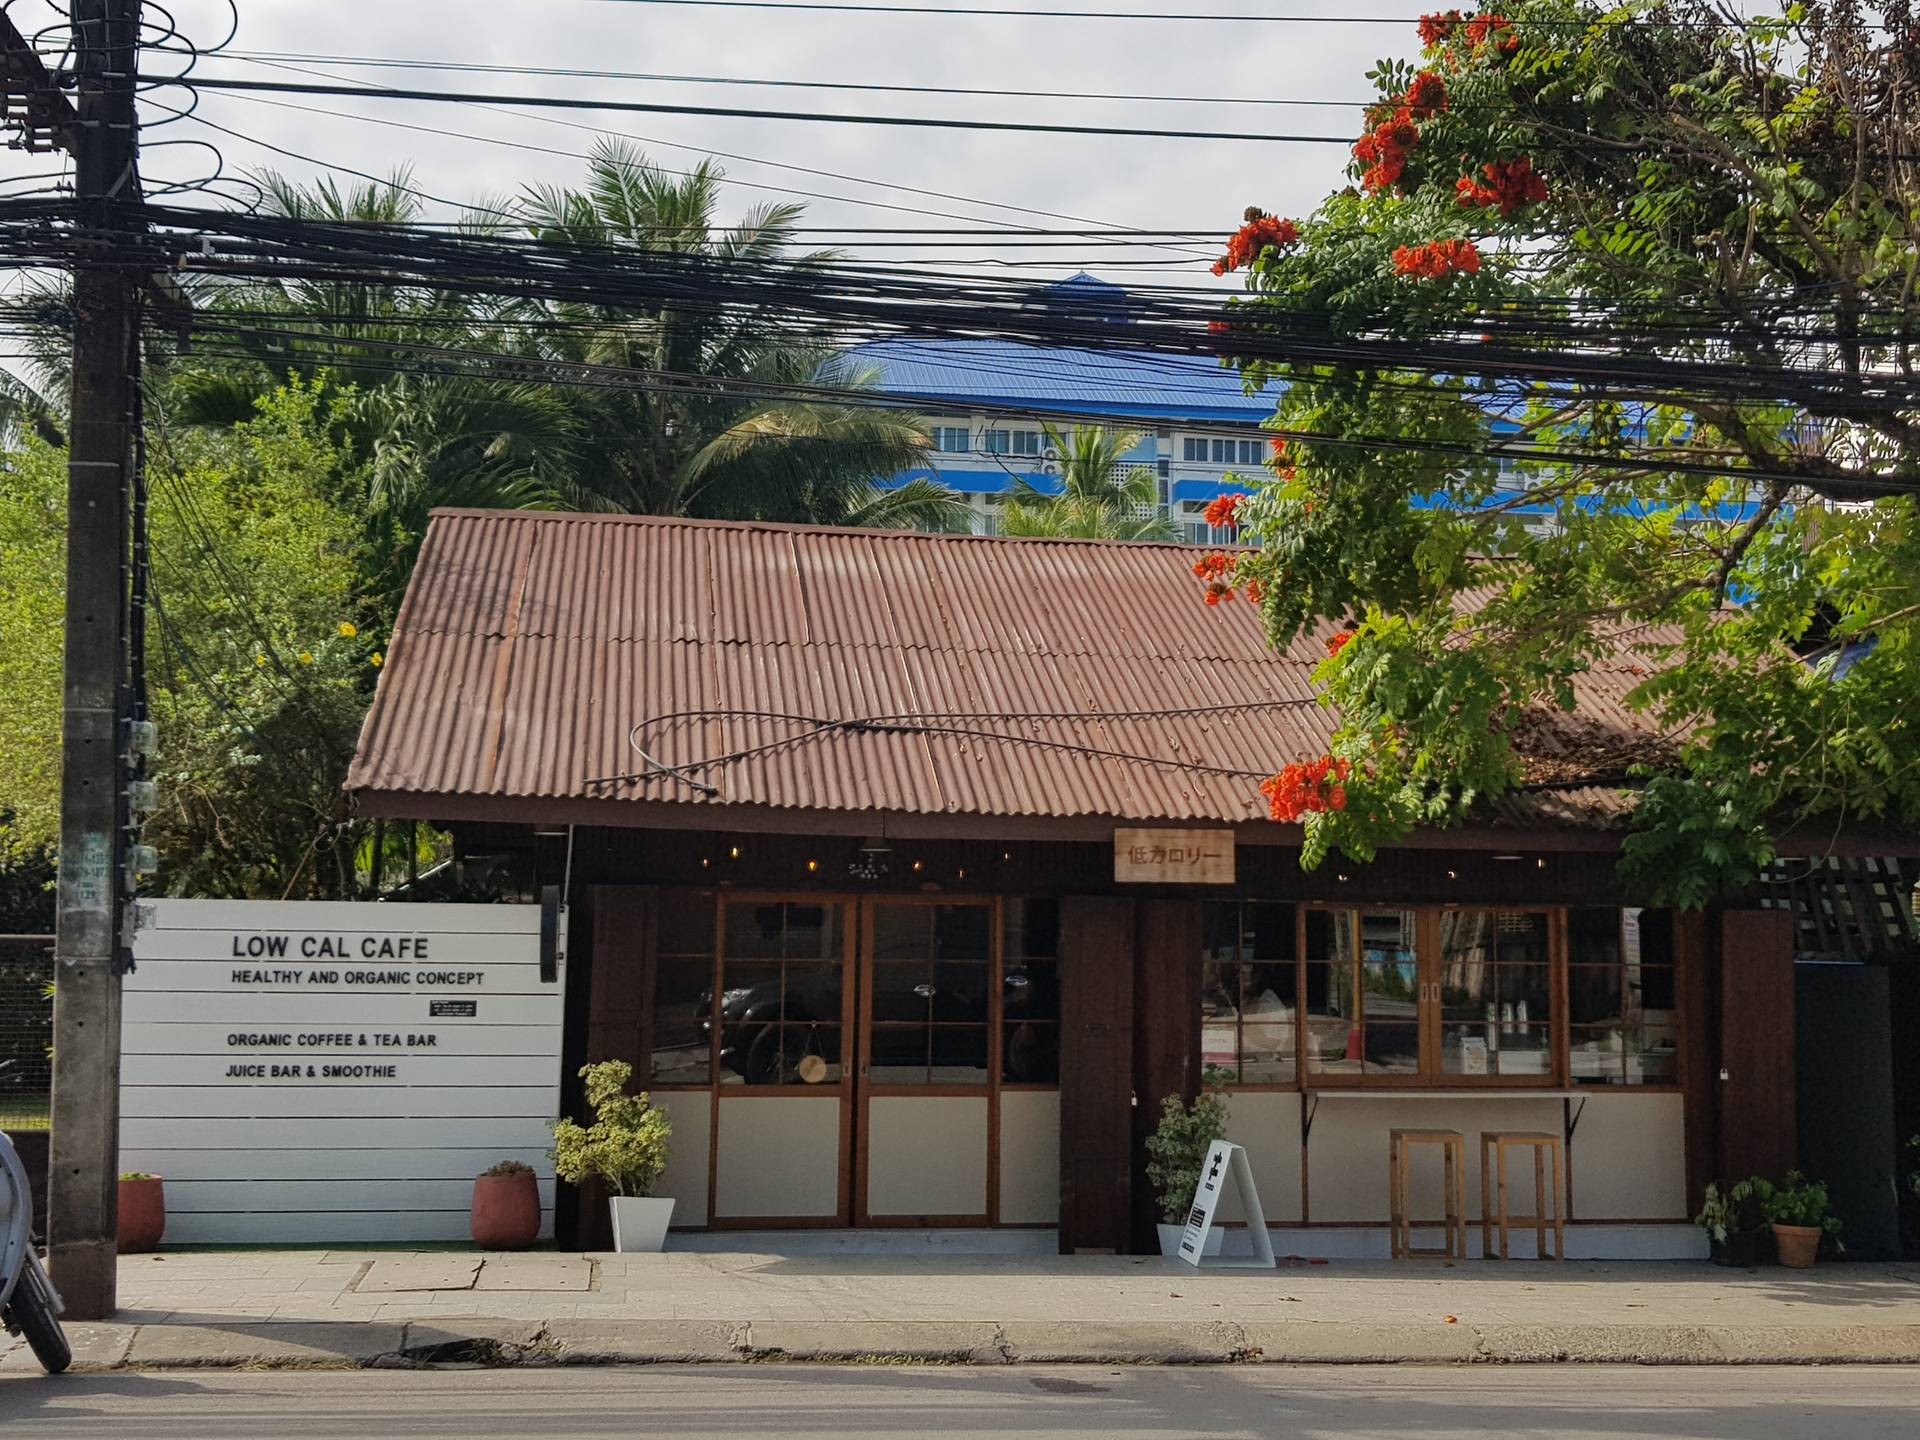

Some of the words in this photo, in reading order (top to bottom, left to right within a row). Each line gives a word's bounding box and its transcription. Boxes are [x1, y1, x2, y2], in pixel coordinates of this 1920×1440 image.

[1128, 845, 1221, 865] 低カロリー
[232, 936, 289, 958] LOW
[300, 936, 351, 958] CAL
[360, 937, 429, 959] CAFE
[231, 969, 303, 985] HEALTHY
[307, 970, 339, 985] AND
[344, 970, 411, 985] ORGANIC
[415, 971, 485, 986] CONCEPT
[226, 1033, 293, 1047] ORGANIC
[297, 1033, 353, 1047] COFFEE
[357, 1033, 368, 1047] &
[373, 1033, 402, 1047] TEA
[407, 1033, 437, 1047] BAR
[225, 1064, 266, 1079] JUICE
[270, 1064, 301, 1078] BAR
[306, 1064, 316, 1078] &
[321, 1064, 397, 1078] SMOOTHIE
